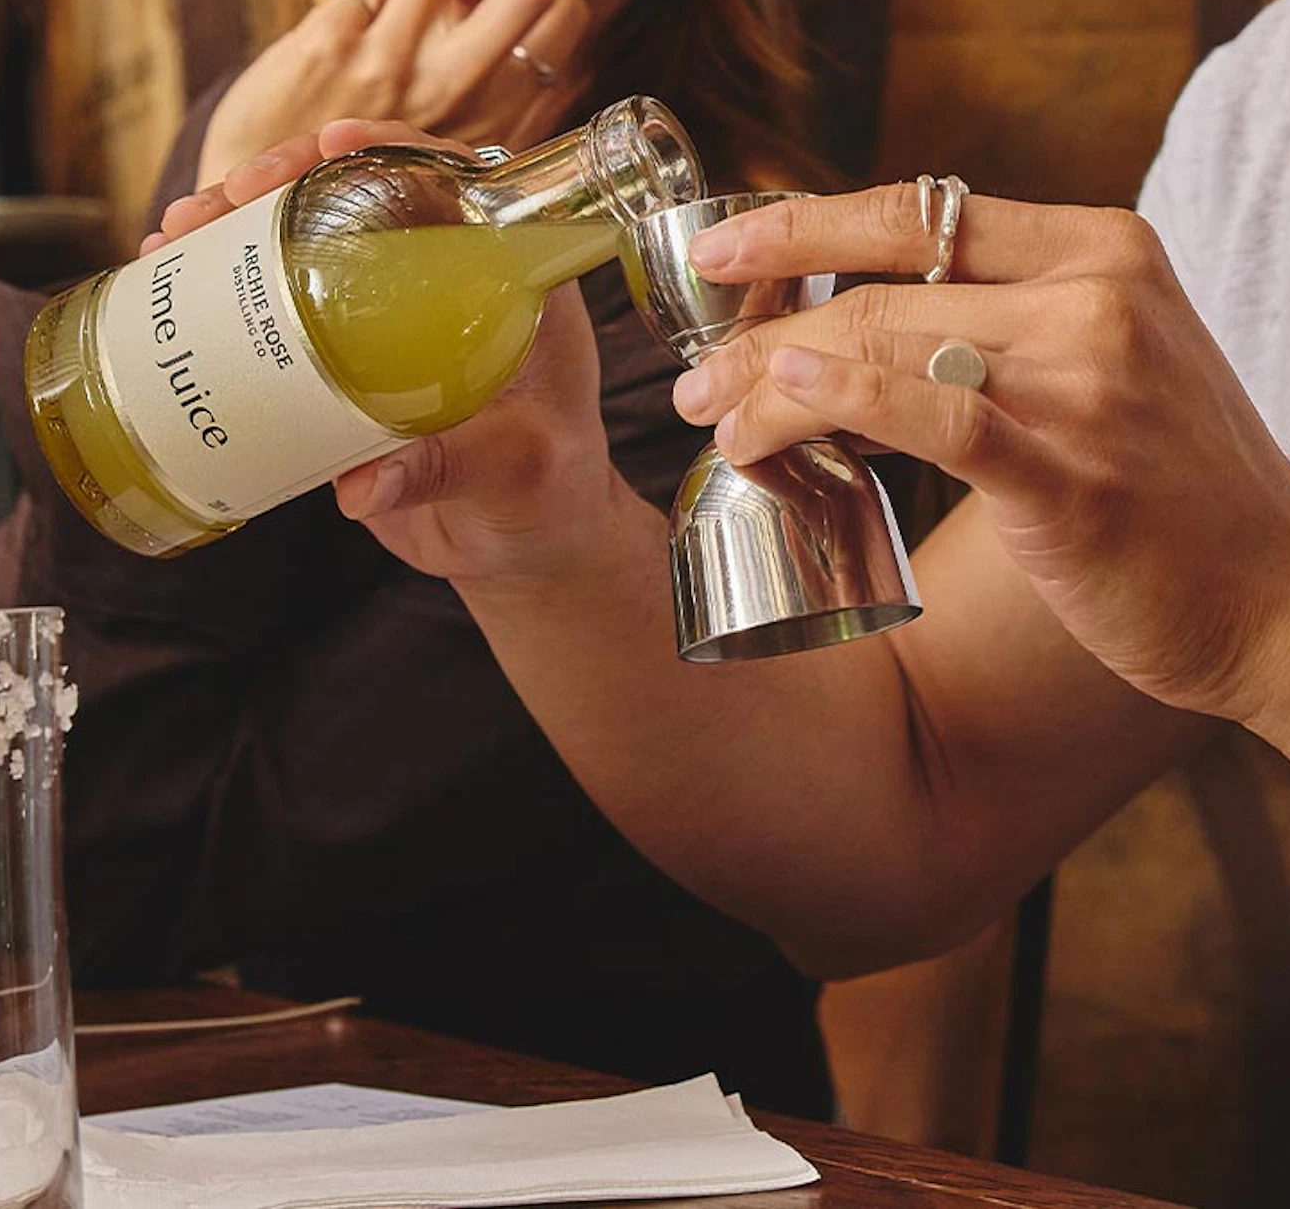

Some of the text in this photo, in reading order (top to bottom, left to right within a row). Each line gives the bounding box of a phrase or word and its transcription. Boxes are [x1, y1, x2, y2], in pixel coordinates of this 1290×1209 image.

[152, 252, 185, 344] Lime
[232, 265, 257, 336] DISTILLING
[243, 244, 294, 370] ARCHIE ROSE
[156, 350, 228, 449] Juice
